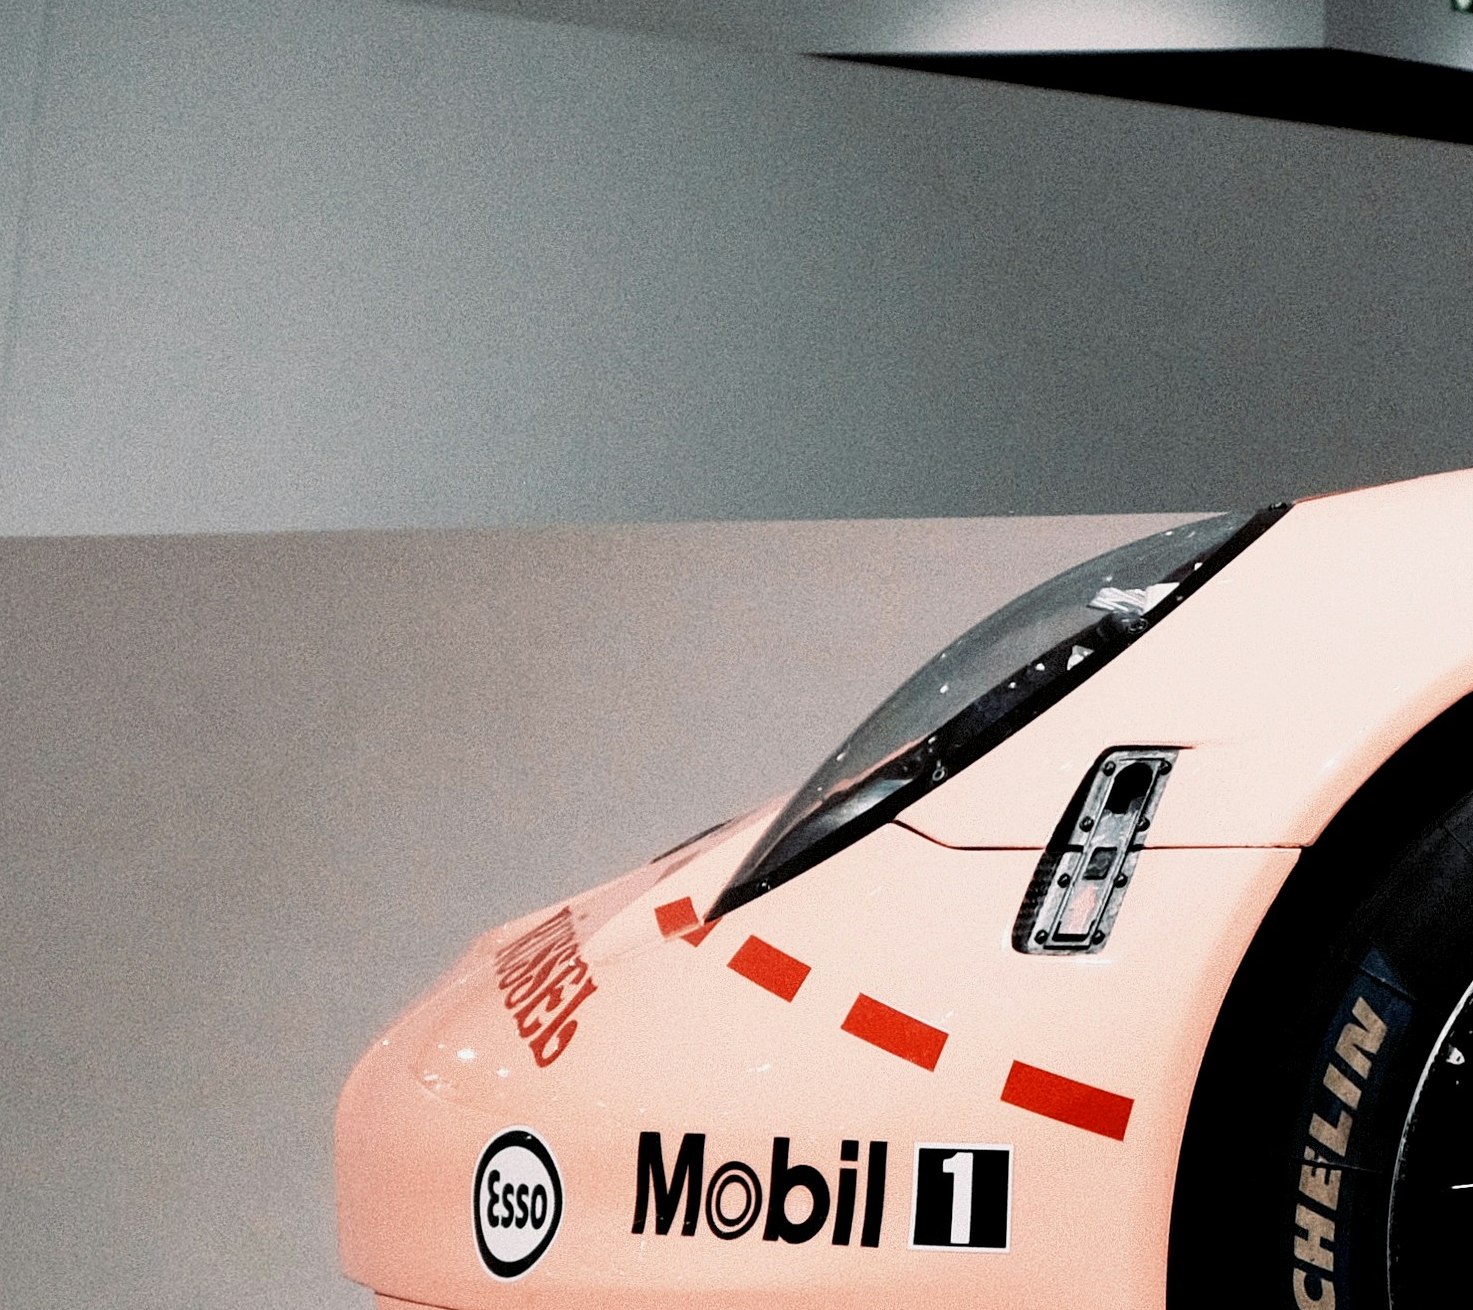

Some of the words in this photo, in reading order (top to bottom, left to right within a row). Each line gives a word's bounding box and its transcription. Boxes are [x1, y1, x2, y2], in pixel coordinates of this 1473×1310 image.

[486, 1168, 549, 1231] Esso
[631, 1131, 889, 1248] Mobil
[941, 1150, 975, 1245] 1
